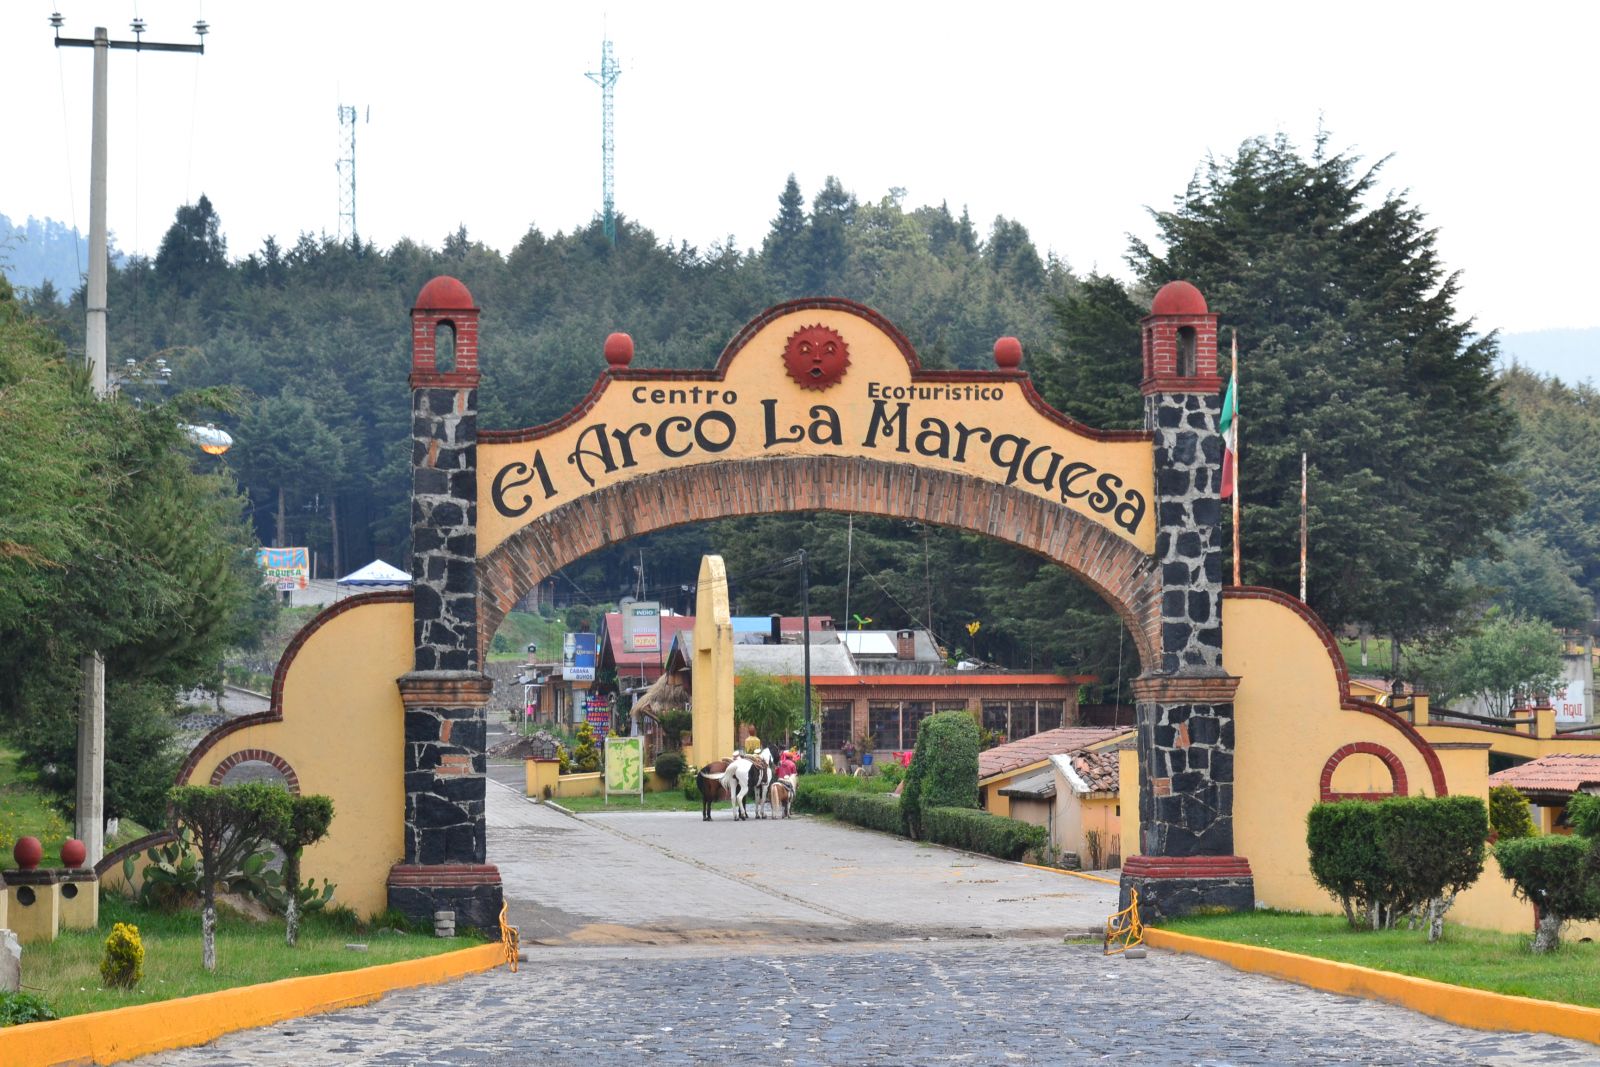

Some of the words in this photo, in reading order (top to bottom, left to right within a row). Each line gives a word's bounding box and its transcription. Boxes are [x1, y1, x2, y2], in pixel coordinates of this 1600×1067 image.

[632, 385, 737, 405] Centro
[867, 381, 1004, 402] Ecoturistico
[491, 448, 559, 518] El
[567, 409, 737, 488] Arco
[760, 398, 843, 449] La
[861, 399, 1146, 536] Marquesa
[1563, 703, 1583, 718] AQUI
